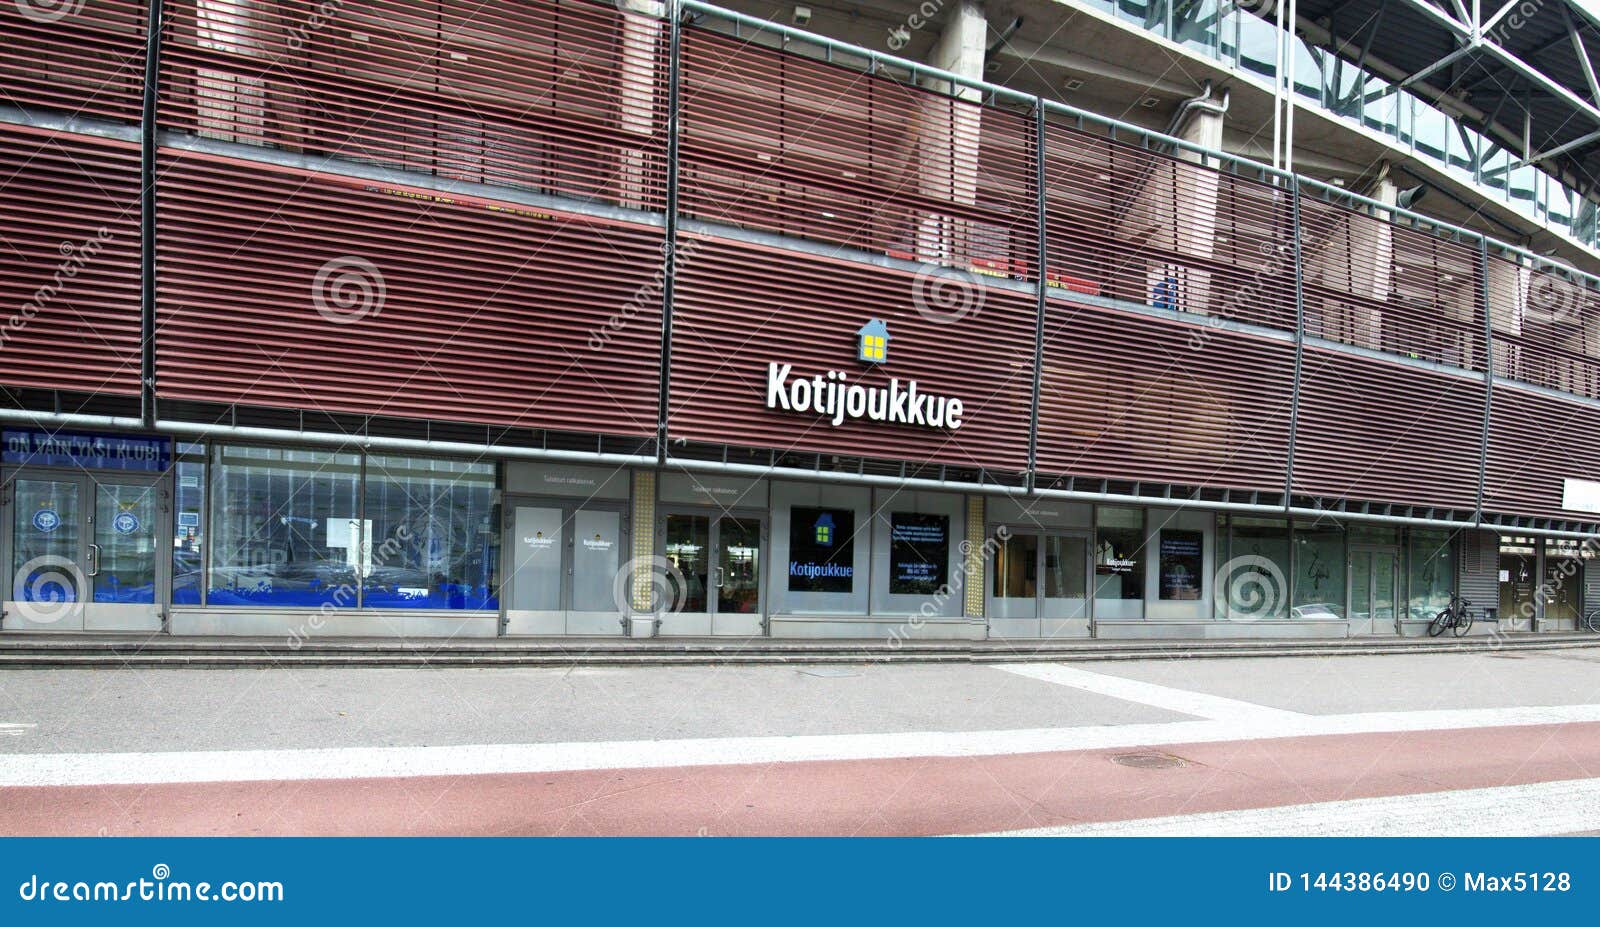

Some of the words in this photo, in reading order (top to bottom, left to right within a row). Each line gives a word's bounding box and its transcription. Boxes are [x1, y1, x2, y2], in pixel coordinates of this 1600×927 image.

[767, 361, 963, 430] Kotijoukkue
[8, 437, 30, 454] ON
[35, 438, 71, 457] VAIN
[77, 441, 111, 458] YKSI
[789, 561, 853, 580] Kotijoukkue
